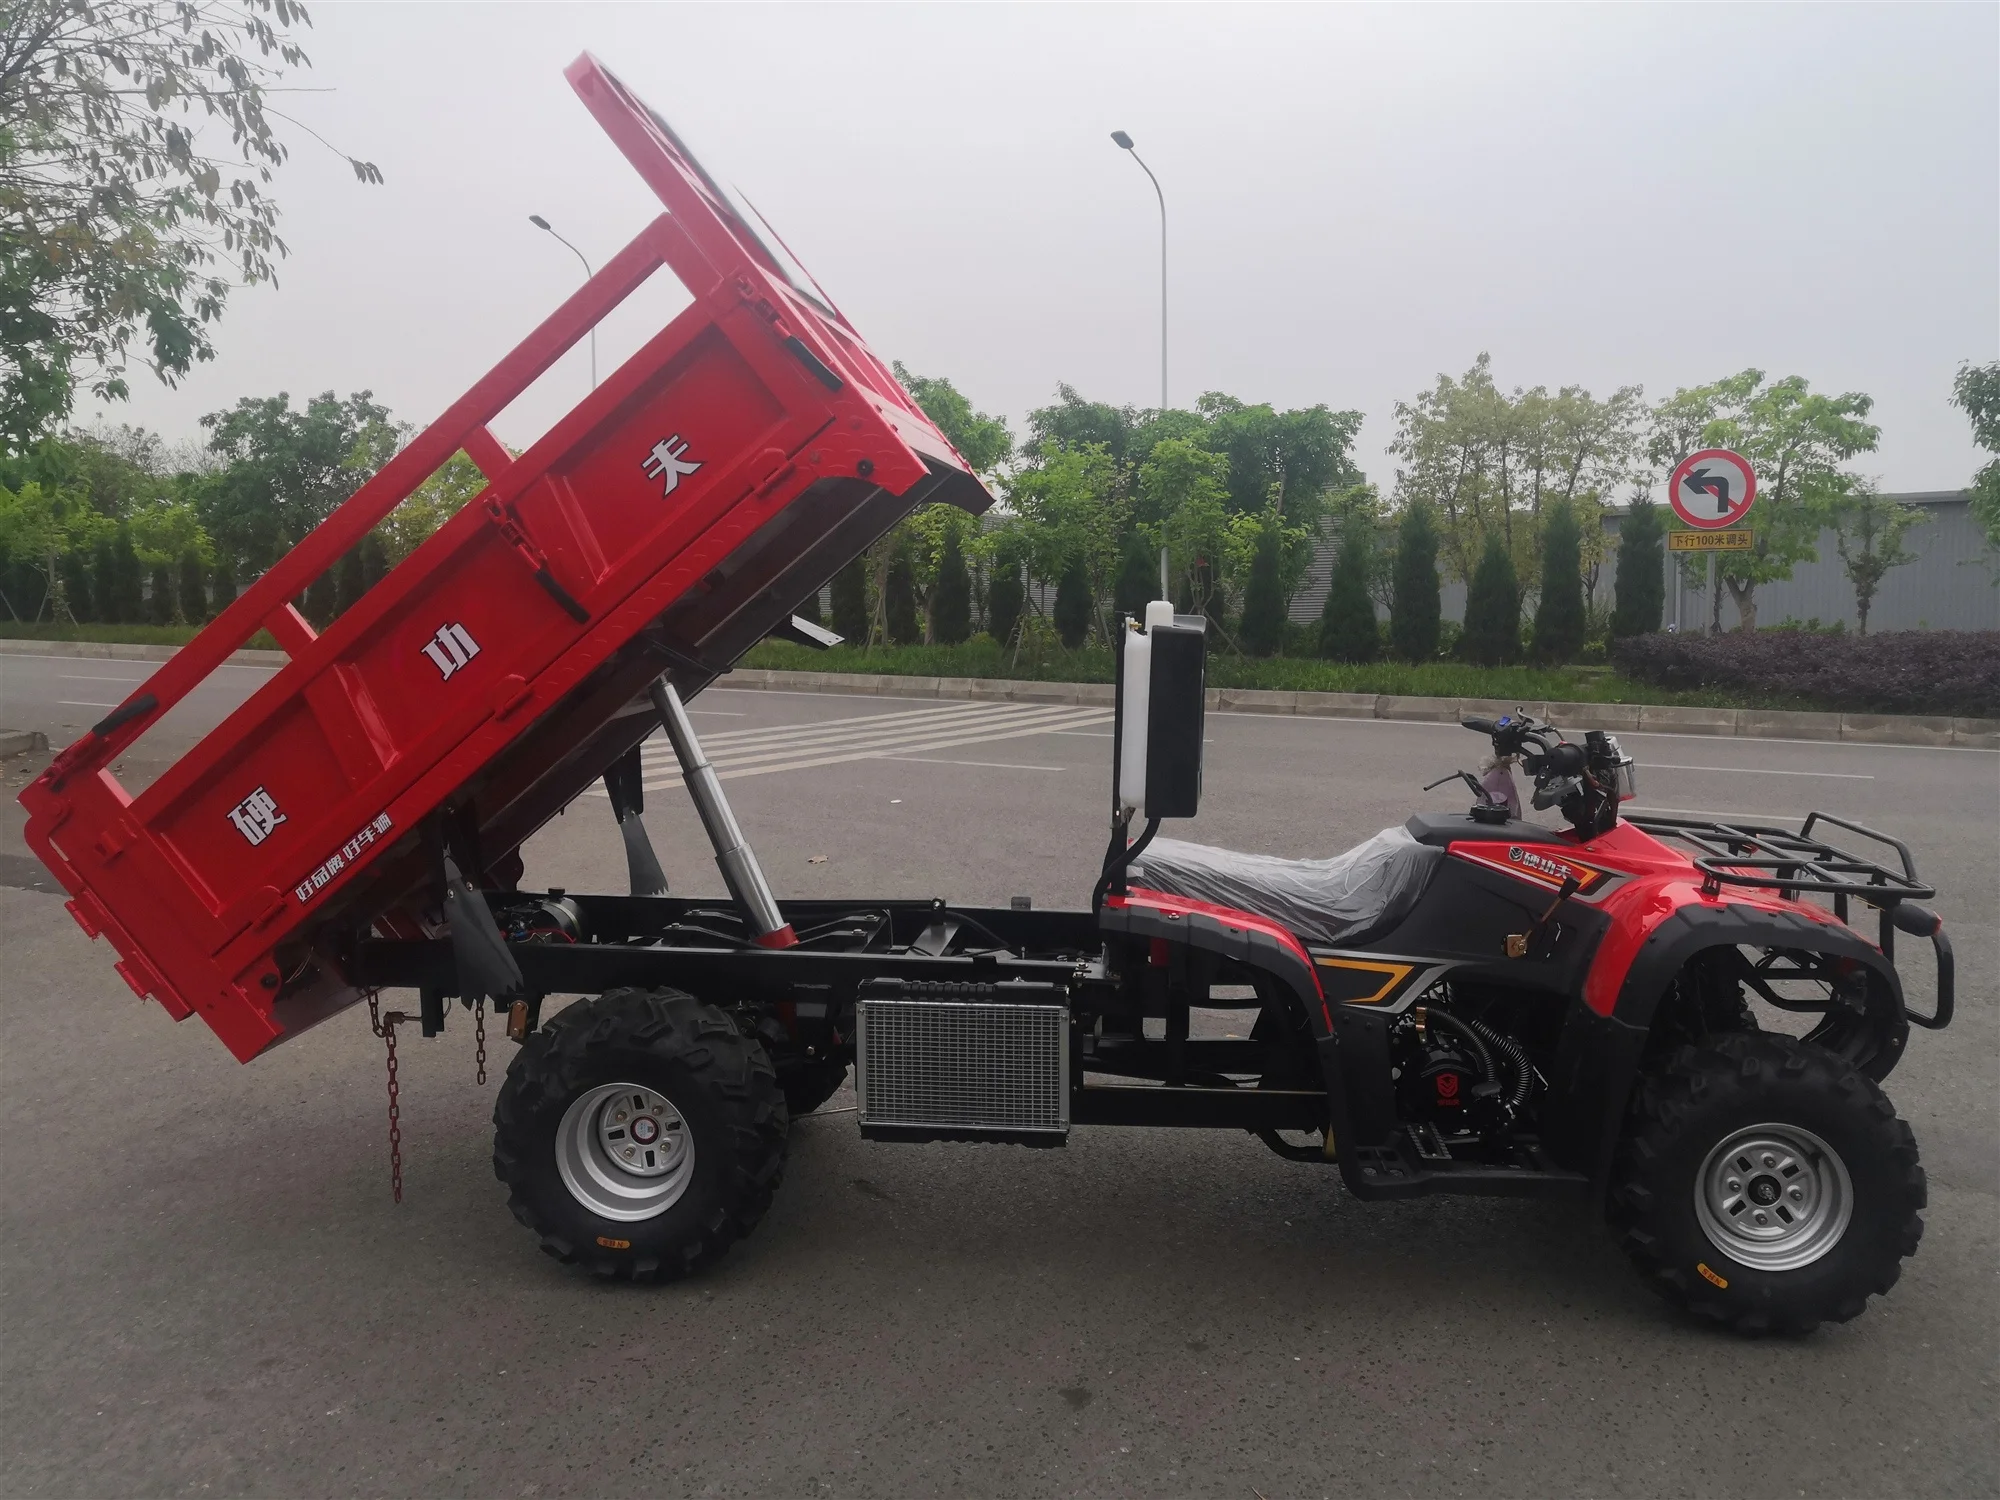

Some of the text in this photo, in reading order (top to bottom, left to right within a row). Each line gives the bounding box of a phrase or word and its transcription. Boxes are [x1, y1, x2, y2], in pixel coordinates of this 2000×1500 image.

[1673, 534, 1748, 547] 下行100米调头
[227, 434, 703, 846] 硬 功 夫
[295, 812, 392, 902] 好品牌 好车辆
[1523, 852, 1572, 879] 硬功夫
